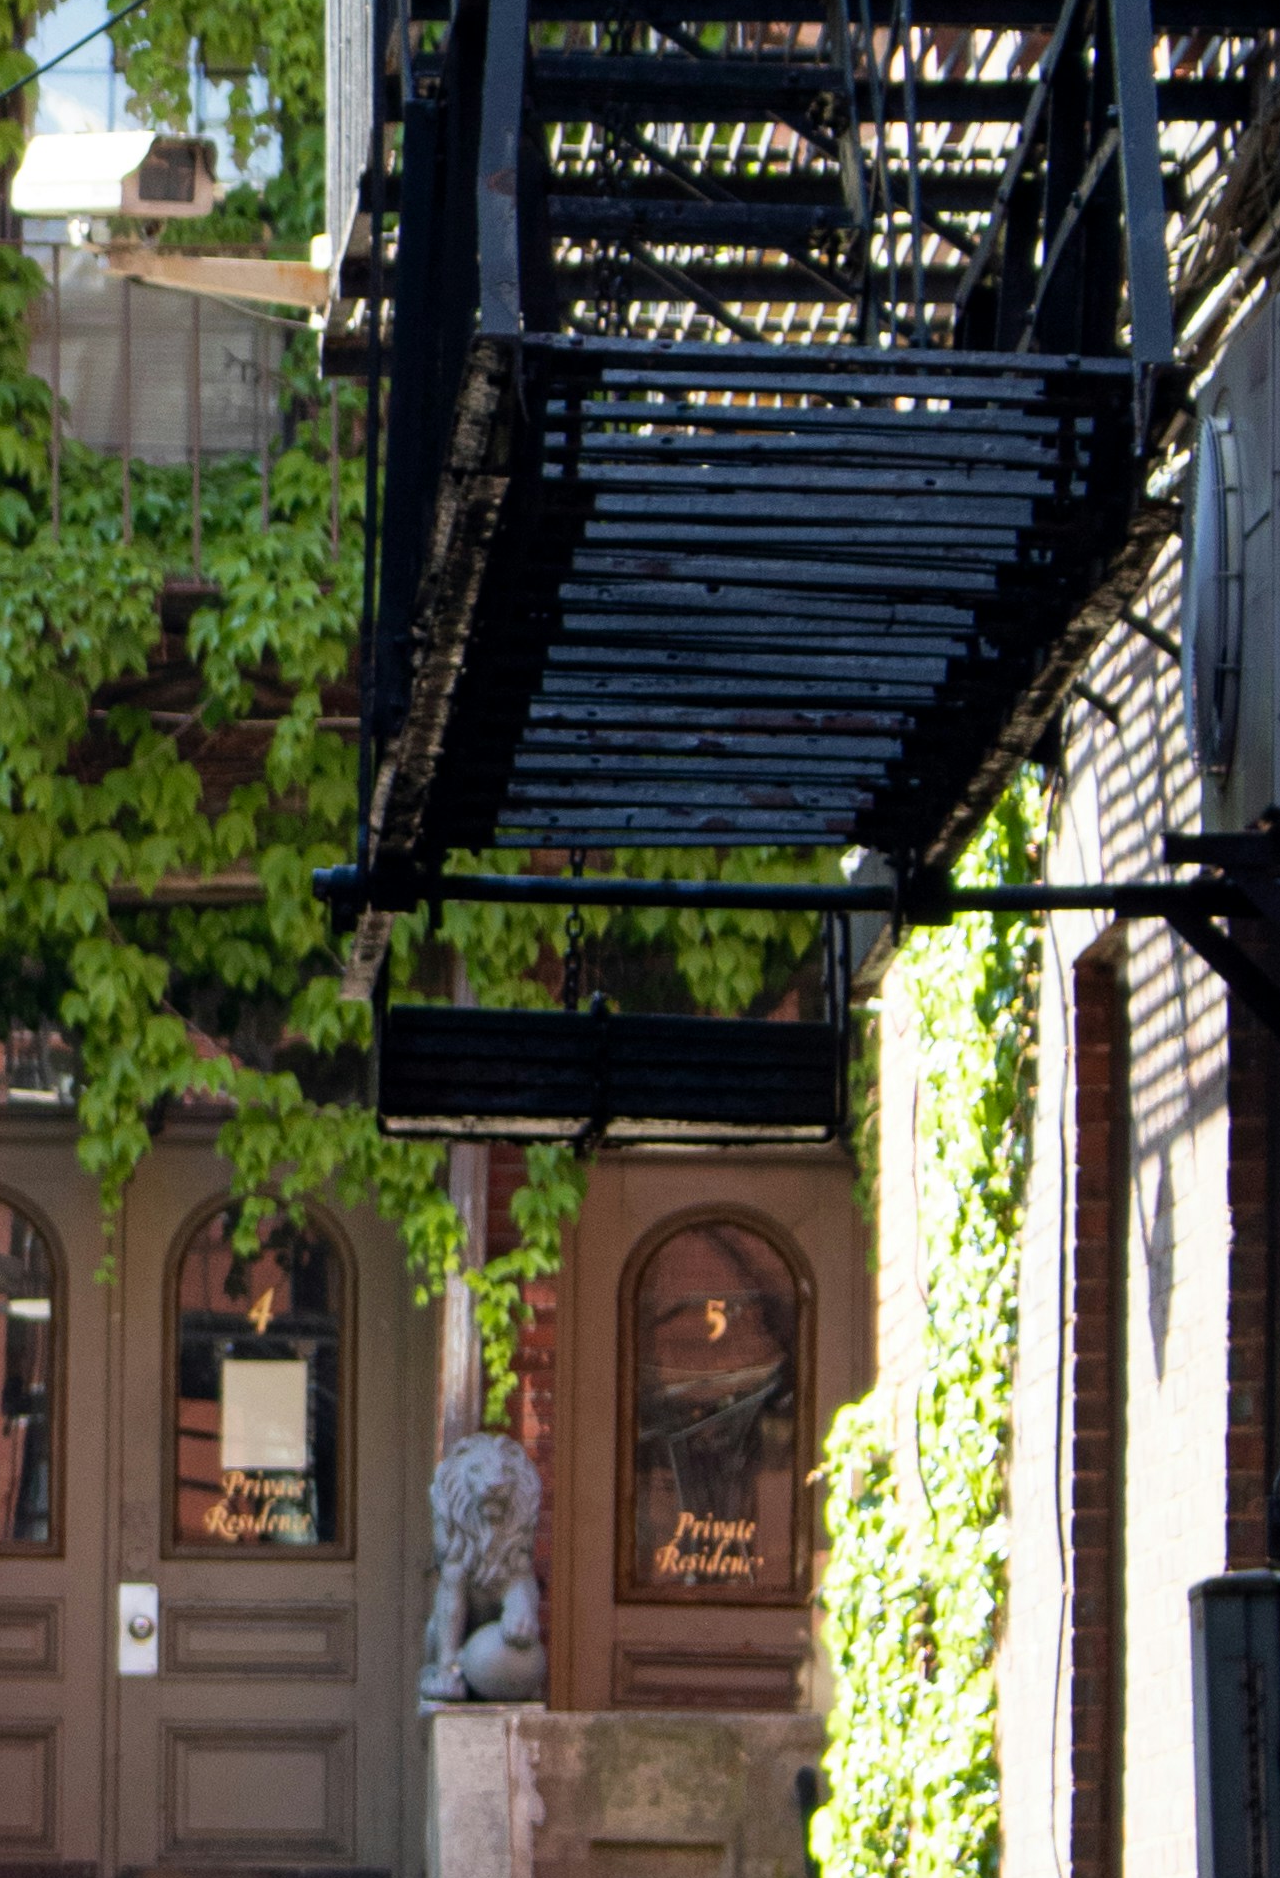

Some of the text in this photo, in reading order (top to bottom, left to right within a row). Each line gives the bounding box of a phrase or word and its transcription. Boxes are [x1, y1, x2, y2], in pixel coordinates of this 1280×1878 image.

[248, 1287, 275, 1335] 4
[706, 1299, 728, 1342] 5
[221, 1470, 306, 1498] Private
[671, 1511, 757, 1543] Private
